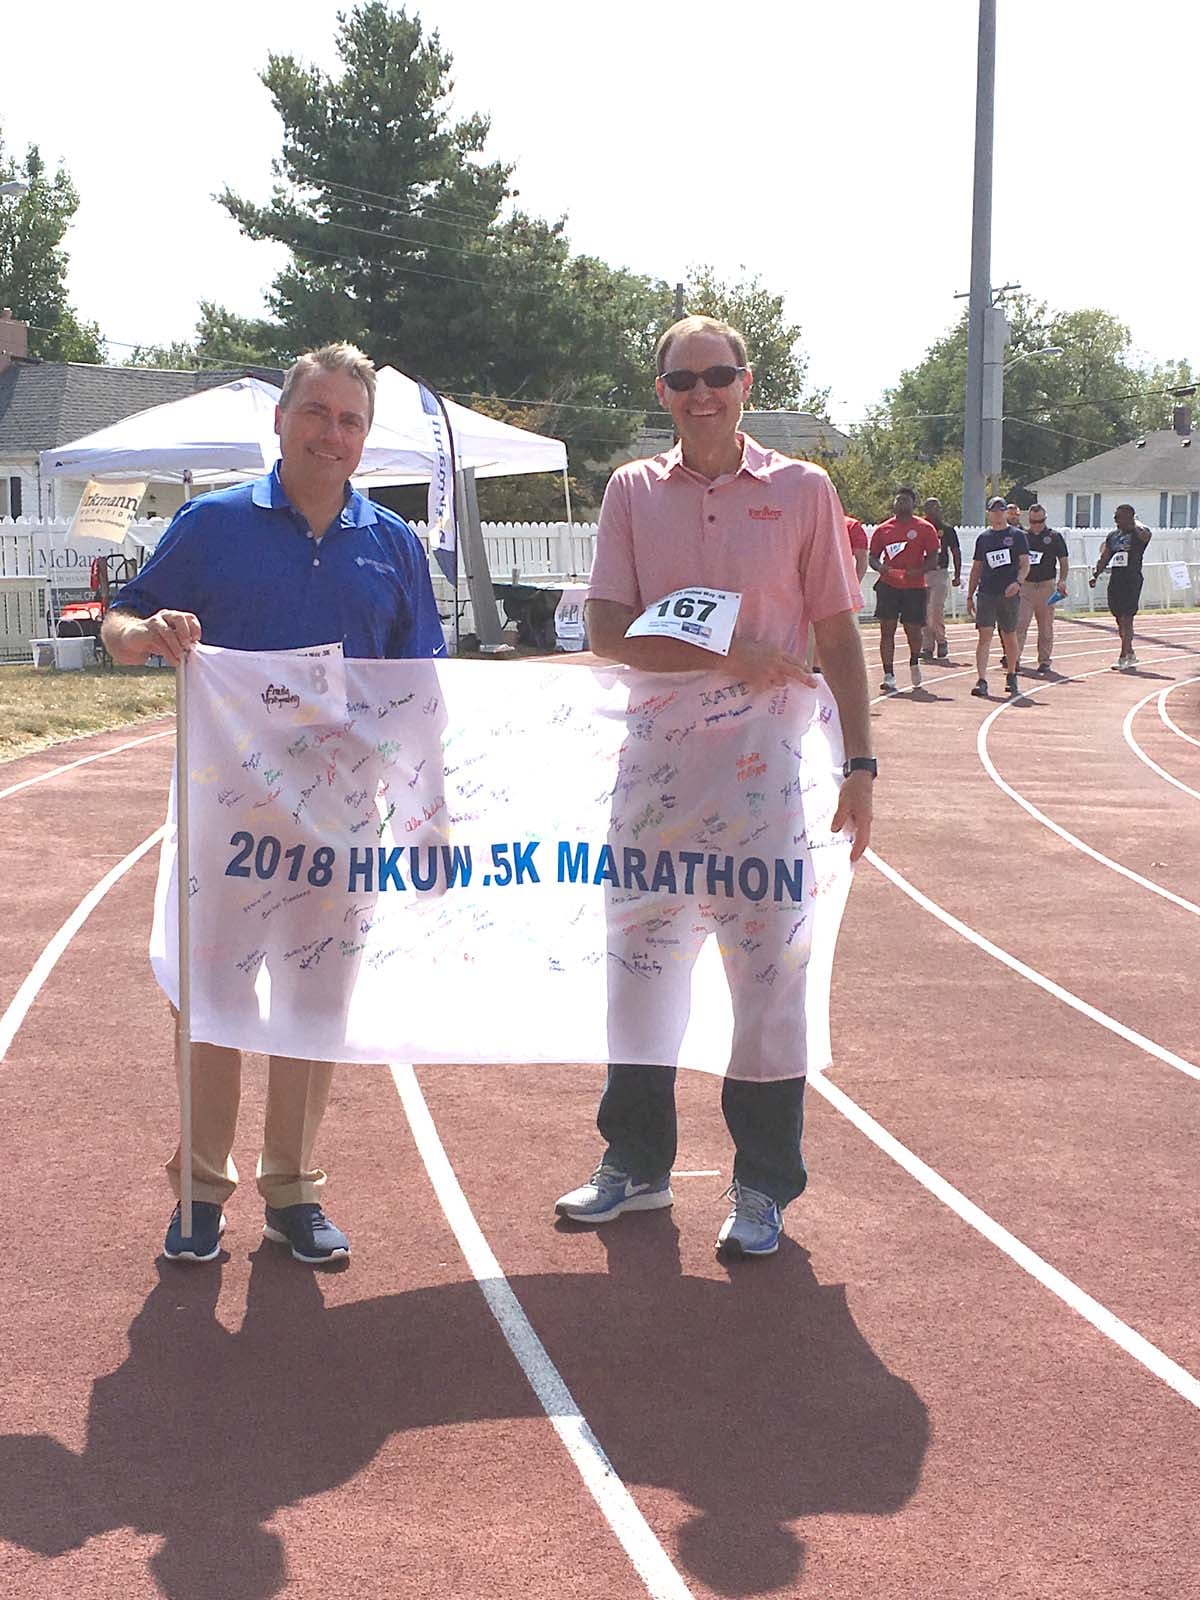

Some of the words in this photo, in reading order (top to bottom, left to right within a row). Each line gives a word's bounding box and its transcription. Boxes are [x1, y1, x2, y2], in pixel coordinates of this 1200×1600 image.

[657, 597, 718, 623] 167
[224, 830, 337, 888] 2018
[347, 844, 473, 893] HKUW
[556, 840, 805, 903] MARATHON
